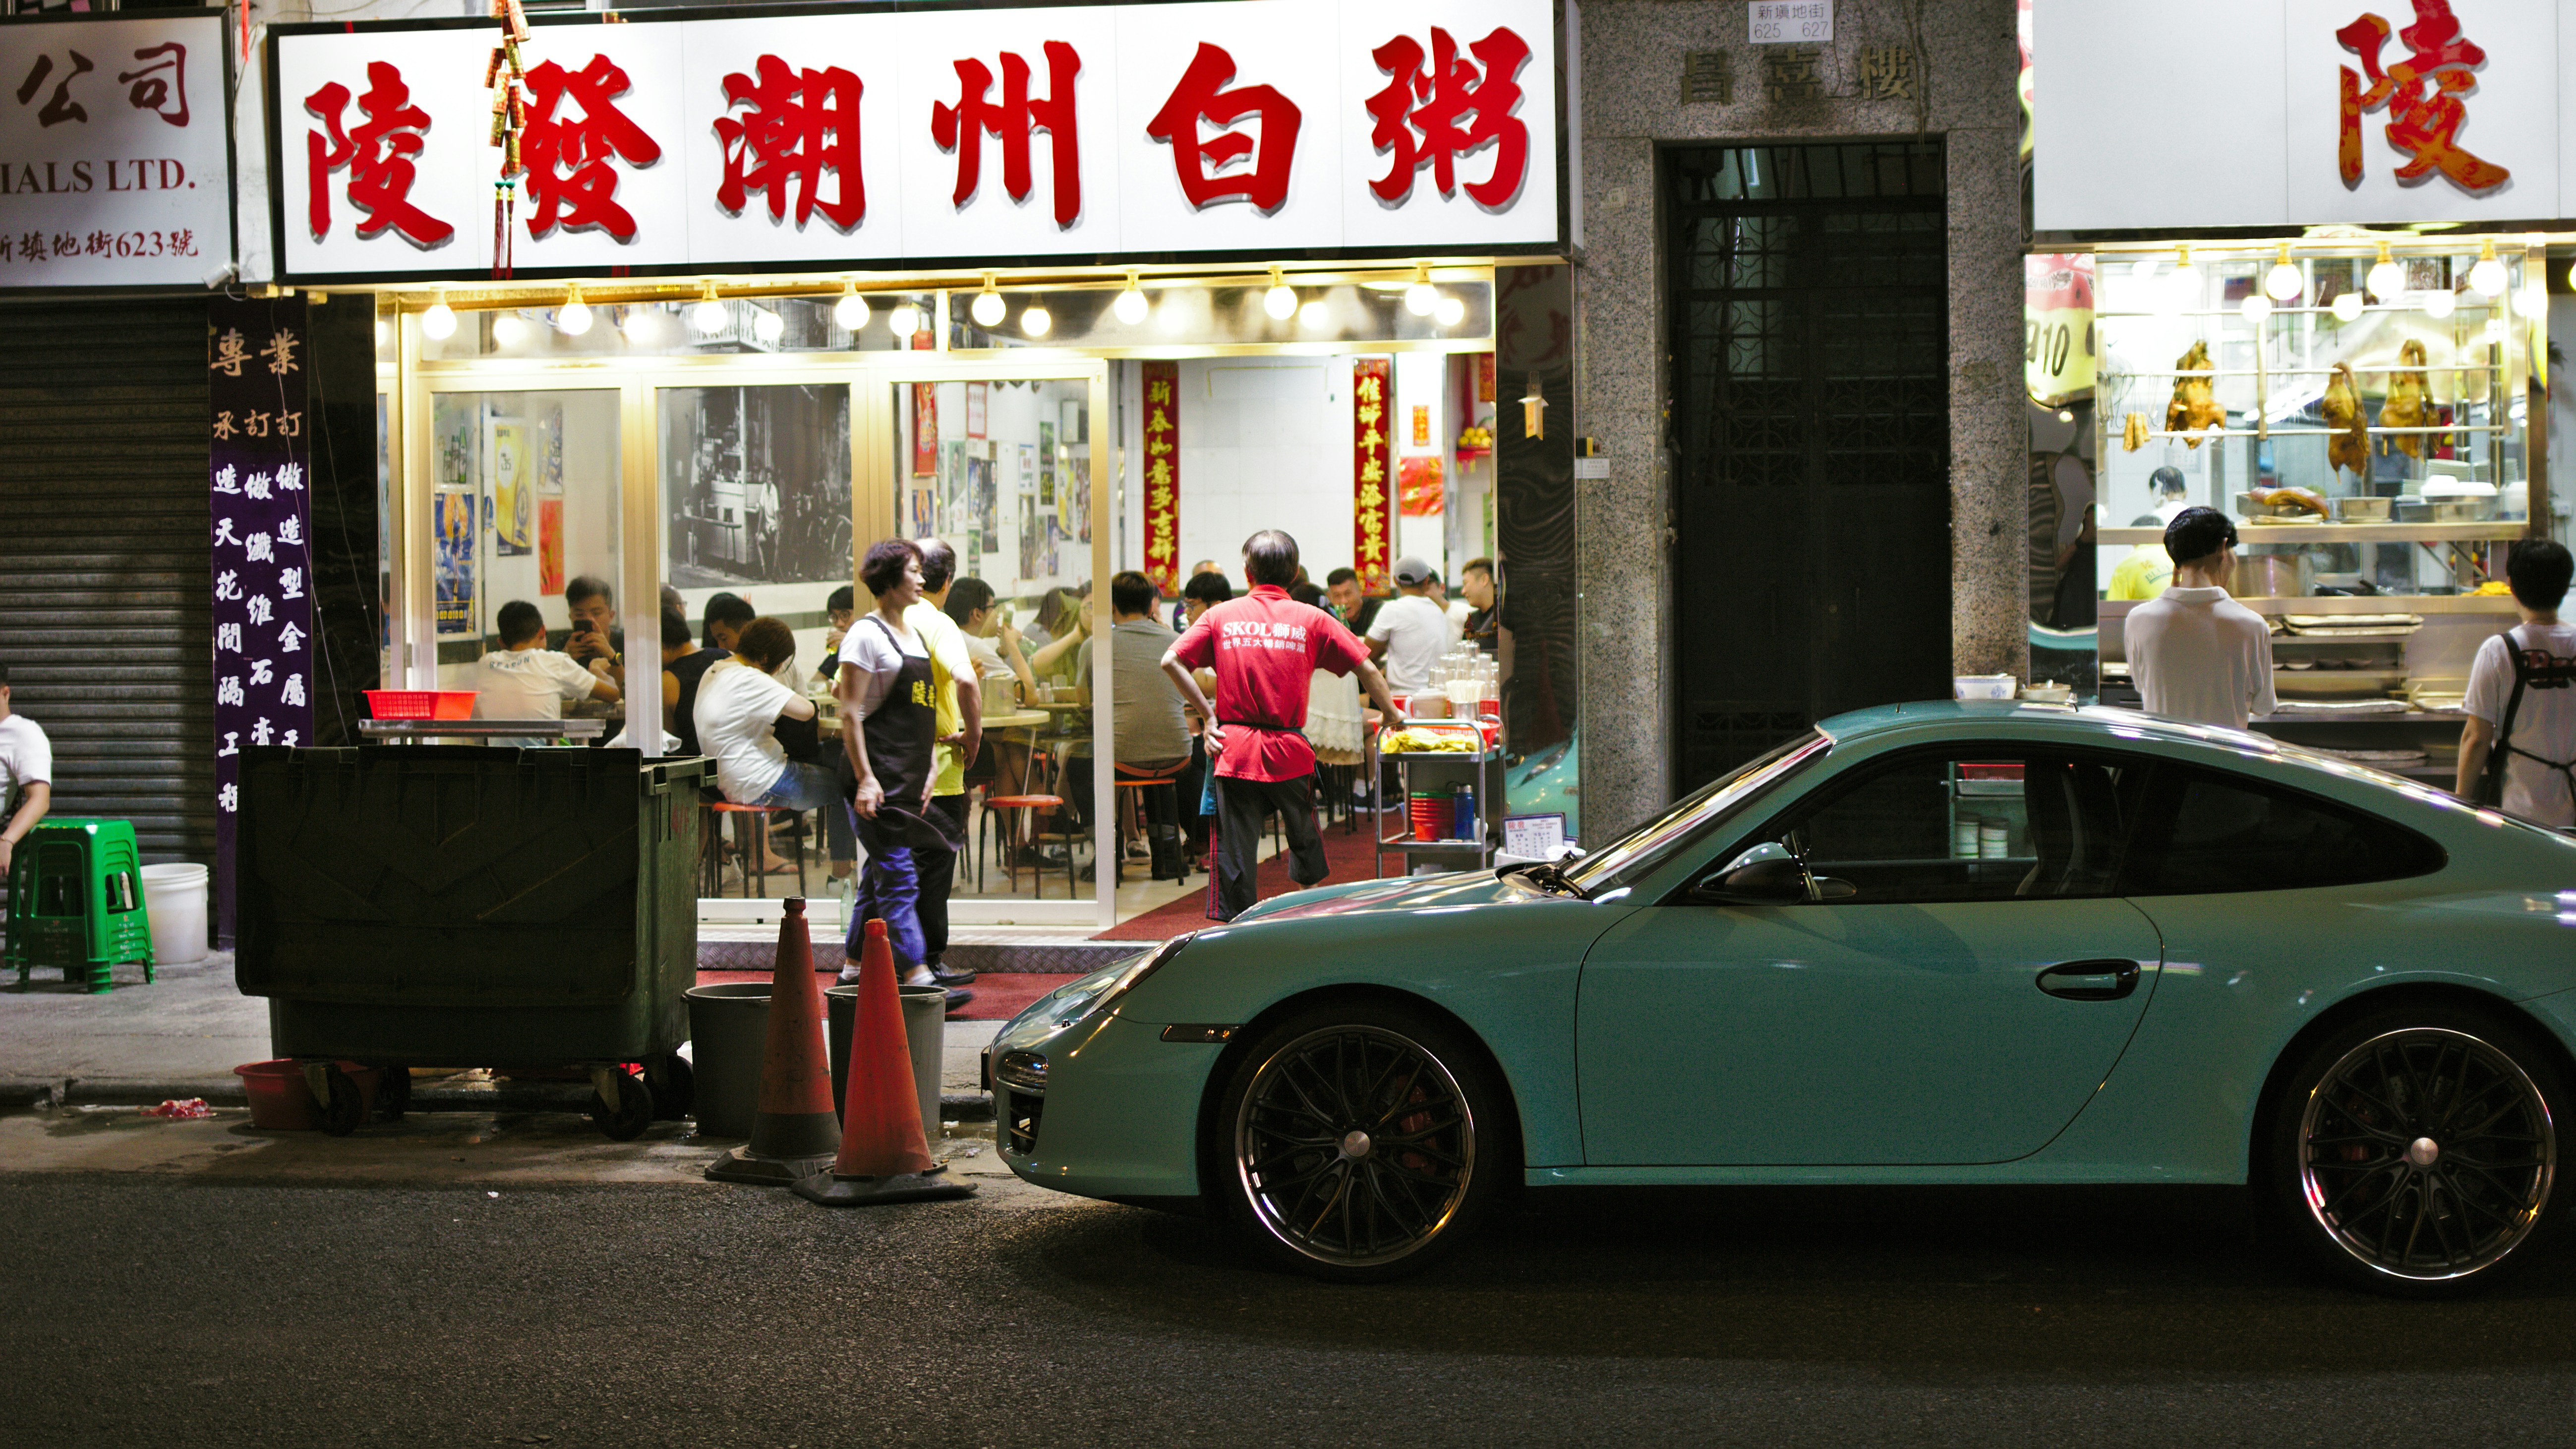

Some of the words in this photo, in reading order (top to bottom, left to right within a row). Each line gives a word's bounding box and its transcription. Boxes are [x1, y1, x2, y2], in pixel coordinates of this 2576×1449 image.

[1755, 23, 1781, 39] 625
[1802, 21, 1828, 37] 627
[16, 42, 190, 128] 公司
[2336, 0, 2512, 194] 陵
[304, 25, 1534, 247] 陵發潮州白粥
[106, 159, 195, 191] LTD.
[210, 327, 300, 377] 專業
[1223, 621, 1272, 638] SKOL
